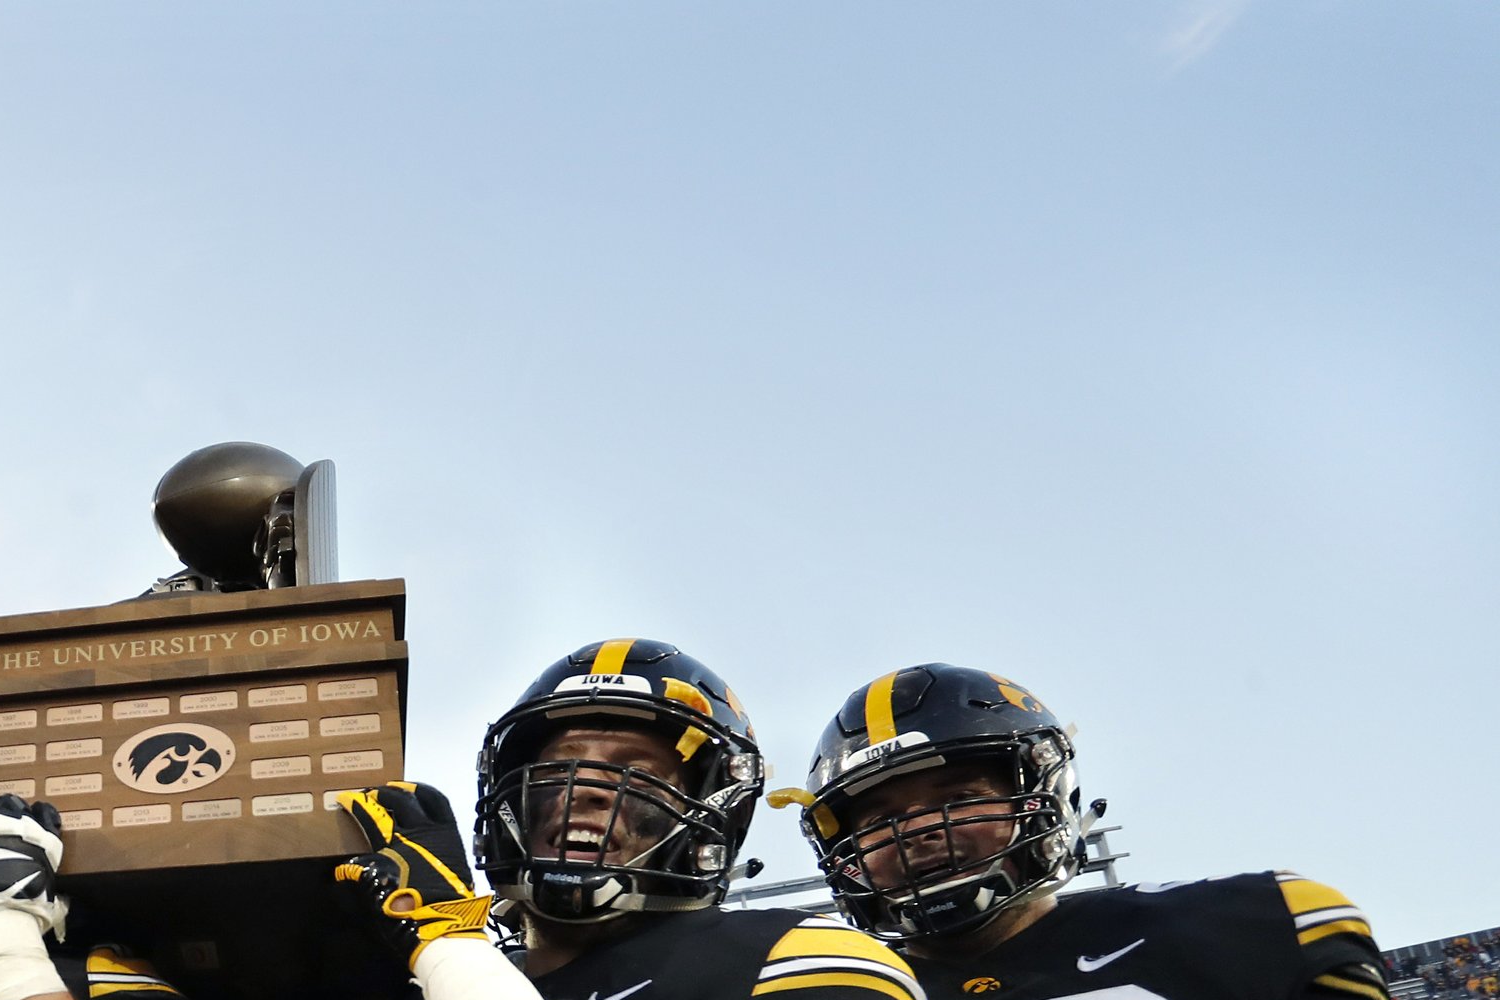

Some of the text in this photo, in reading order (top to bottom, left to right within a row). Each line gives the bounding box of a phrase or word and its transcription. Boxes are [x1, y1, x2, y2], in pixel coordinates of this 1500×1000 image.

[52, 631, 240, 666] UNIVERSITY
[249, 627, 288, 648] OF
[300, 619, 382, 643] IOWA
[582, 674, 625, 685] IOWA
[864, 739, 902, 761] IOWA
